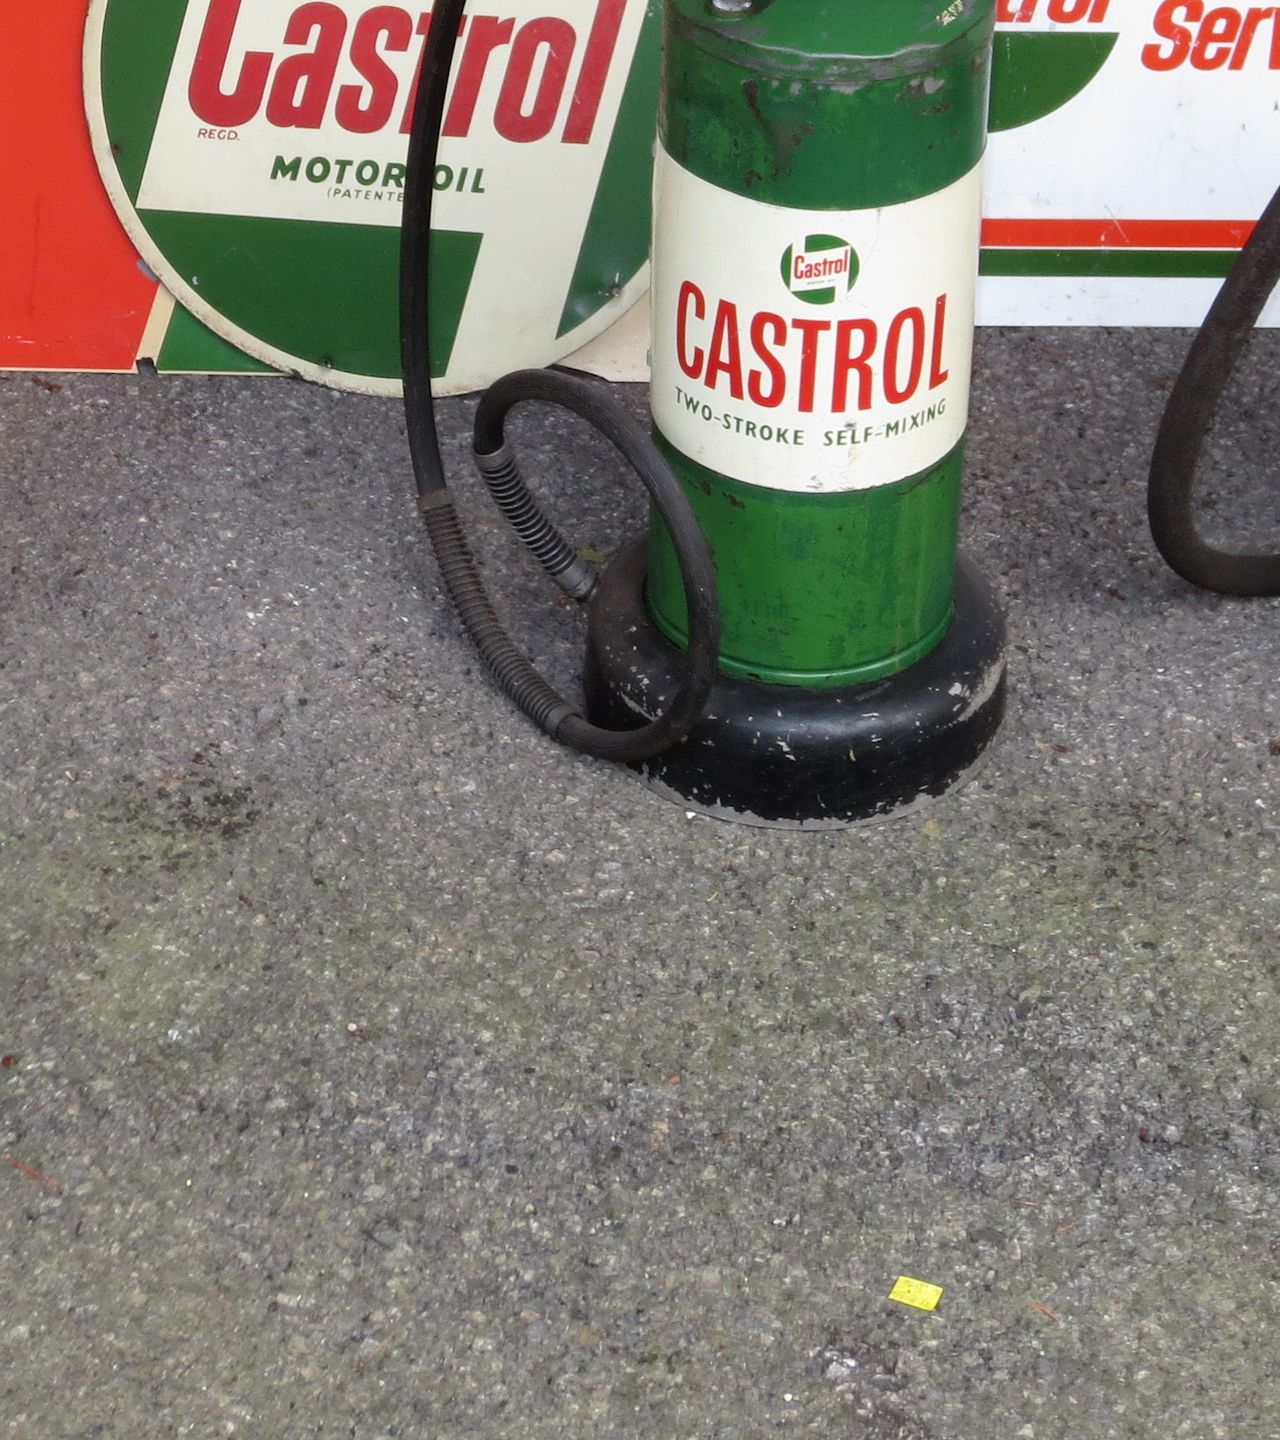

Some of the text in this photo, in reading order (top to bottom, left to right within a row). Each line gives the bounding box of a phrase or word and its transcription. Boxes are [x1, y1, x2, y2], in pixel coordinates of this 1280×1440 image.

[197, 128, 241, 142] REGD.
[270, 155, 486, 194] MOTOR OIL
[326, 187, 406, 203] (PATENTE
[793, 248, 849, 280] Castrol
[676, 280, 949, 414] CASTROL
[675, 385, 947, 447] TWO-STROKE SELF-MIXING
